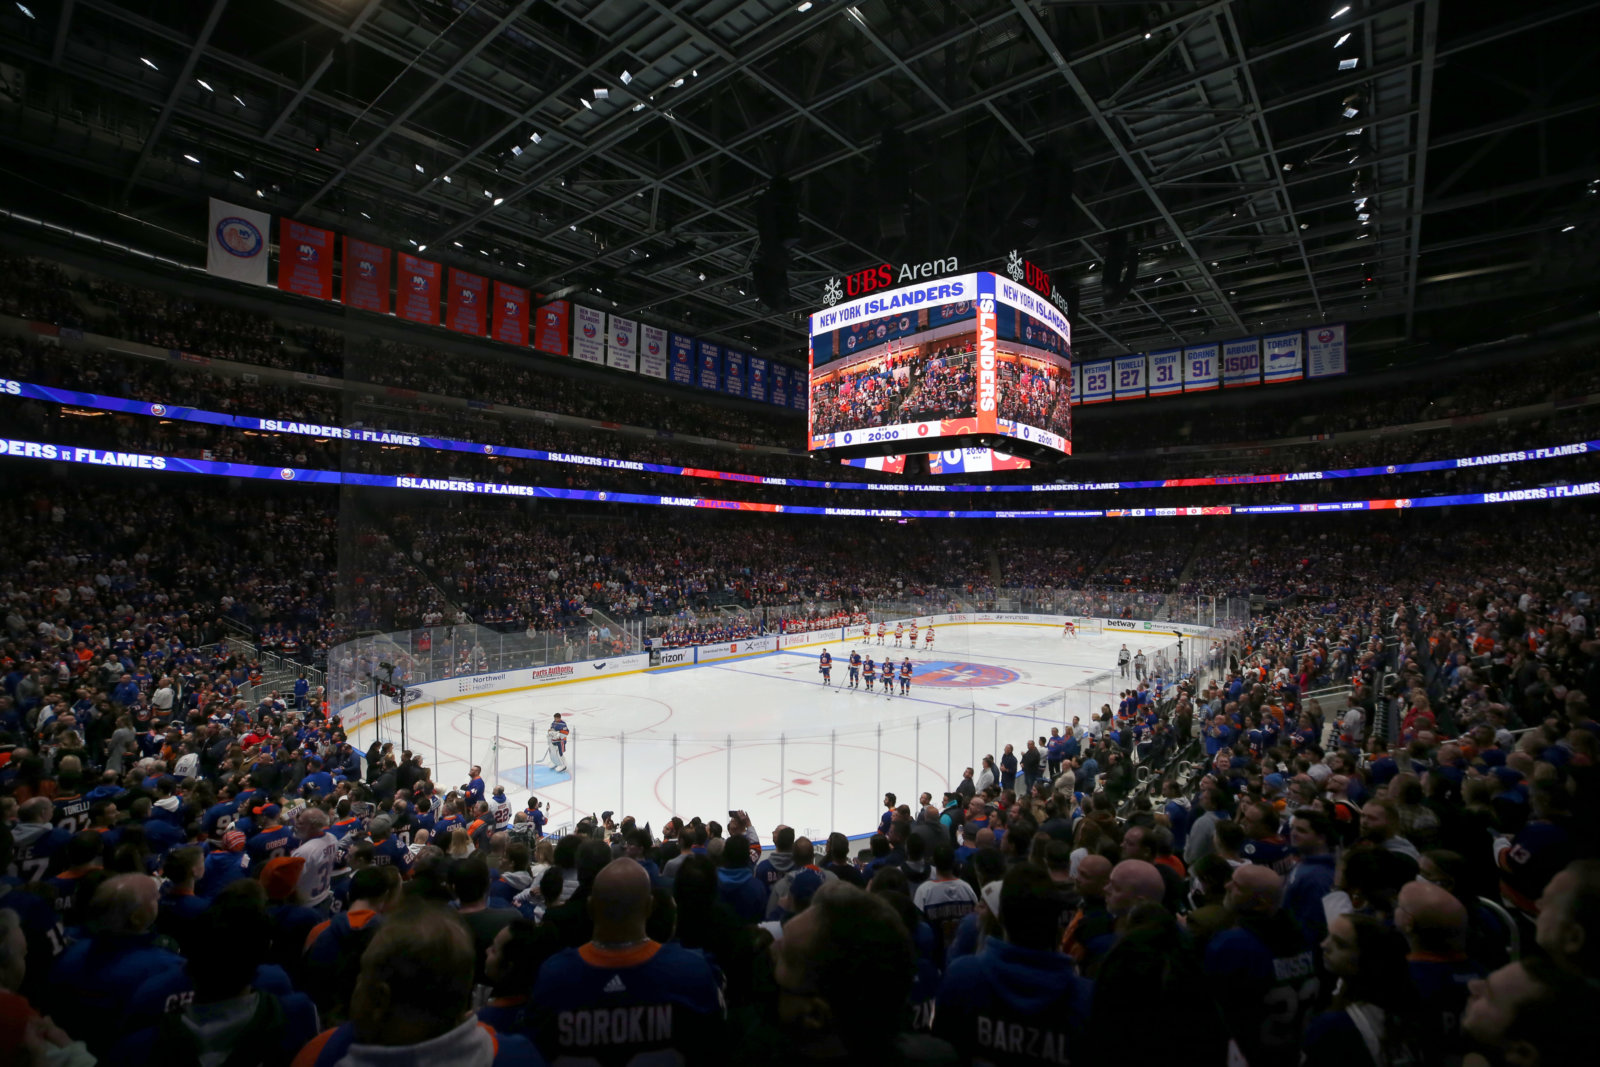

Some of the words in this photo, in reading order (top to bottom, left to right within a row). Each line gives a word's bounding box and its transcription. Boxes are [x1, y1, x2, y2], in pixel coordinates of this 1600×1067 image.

[846, 264, 892, 296] UBS
[898, 256, 958, 283] Arena
[1025, 260, 1050, 296] UBS
[1050, 285, 1070, 316] Arena
[820, 312, 836, 328] NEW
[840, 305, 862, 323] YORK
[864, 282, 964, 315] ISLANDERS
[1003, 284, 1018, 302] NEW
[1020, 291, 1035, 310] YORK
[1036, 300, 1070, 338] ISLANDERS
[980, 292, 994, 412] ISLANDERS
[1227, 344, 1256, 355] ARBOUR
[1268, 338, 1298, 349] TORREY
[1154, 356, 1176, 365] SMITH
[1188, 350, 1215, 360] GORING
[1225, 355, 1258, 372] 1500
[1084, 365, 1110, 374] NYSTROM
[1117, 360, 1143, 370] TONELLI
[1157, 365, 1174, 382] 31
[1192, 360, 1210, 377] 91
[1088, 374, 1106, 391] 23
[1121, 370, 1139, 387] 27
[260, 418, 351, 439] ISLANDERS
[362, 431, 420, 446] FLAMES
[844, 433, 852, 444] 0
[868, 431, 899, 442] 20:00
[918, 424, 928, 436] 0
[1024, 427, 1030, 438] 0
[1038, 434, 1052, 446] 20:00
[1058, 438, 1062, 448] 0
[75, 448, 166, 470] FLAMES
[548, 452, 602, 466] ISLANDERS
[609, 459, 644, 471] FLAMES
[1457, 452, 1526, 468] ISLANDERS
[1536, 443, 1588, 458] FLAMES
[760, 476, 786, 486] FLAMES
[1280, 472, 1322, 481] FLAMES
[396, 477, 475, 492] ISLANDERS
[484, 482, 534, 496] FLAMES
[868, 484, 908, 492] ISLANDERS
[1032, 484, 1078, 492] ISLANDERS
[1484, 488, 1547, 503] ISLANDERS
[1556, 482, 1600, 496] FLAMES
[660, 496, 705, 507] ISLANDERS
[711, 500, 740, 509] FLAMES
[825, 508, 866, 516] ISLANDERS
[872, 509, 902, 517] FLAMES
[1108, 619, 1136, 628] betway
[662, 653, 683, 664] rizon
[473, 674, 505, 683] Northwell
[532, 670, 547, 679] Parts
[548, 666, 574, 675] Authority
[63, 801, 90, 816] TONELLI
[495, 808, 509, 823] 22
[558, 1003, 672, 1047] SOROKIN
[977, 1015, 1072, 1065] BARZAL
